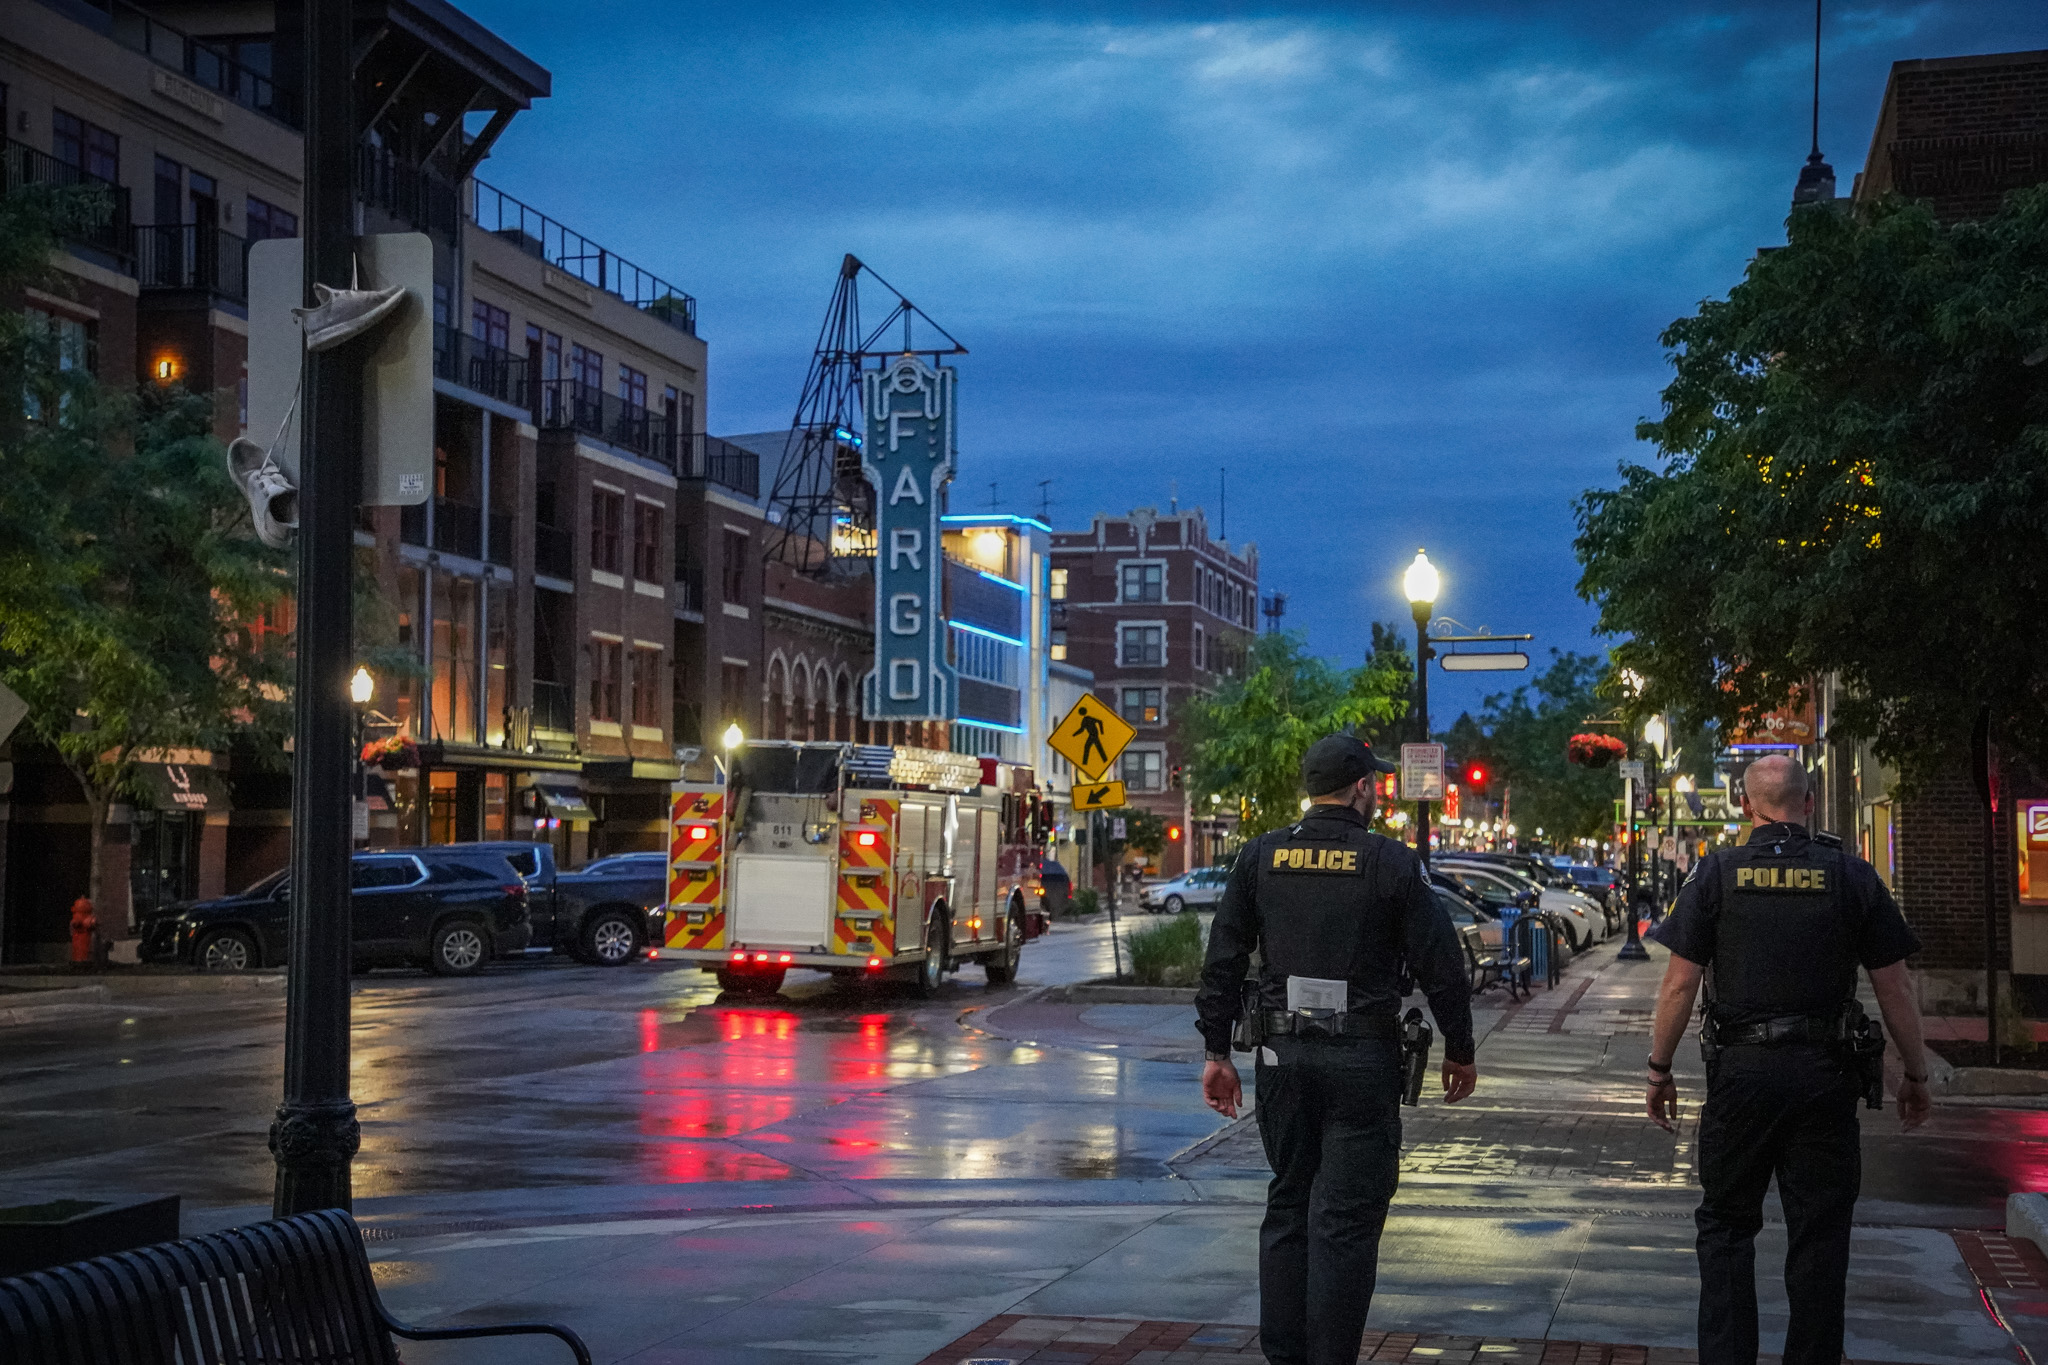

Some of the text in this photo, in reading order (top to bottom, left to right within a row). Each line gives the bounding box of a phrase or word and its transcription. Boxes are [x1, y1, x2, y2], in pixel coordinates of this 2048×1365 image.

[889, 411, 924, 700] FARGO
[773, 825, 792, 836] 811
[1273, 848, 1357, 871] POLICE
[1736, 867, 1826, 889] POLICE
